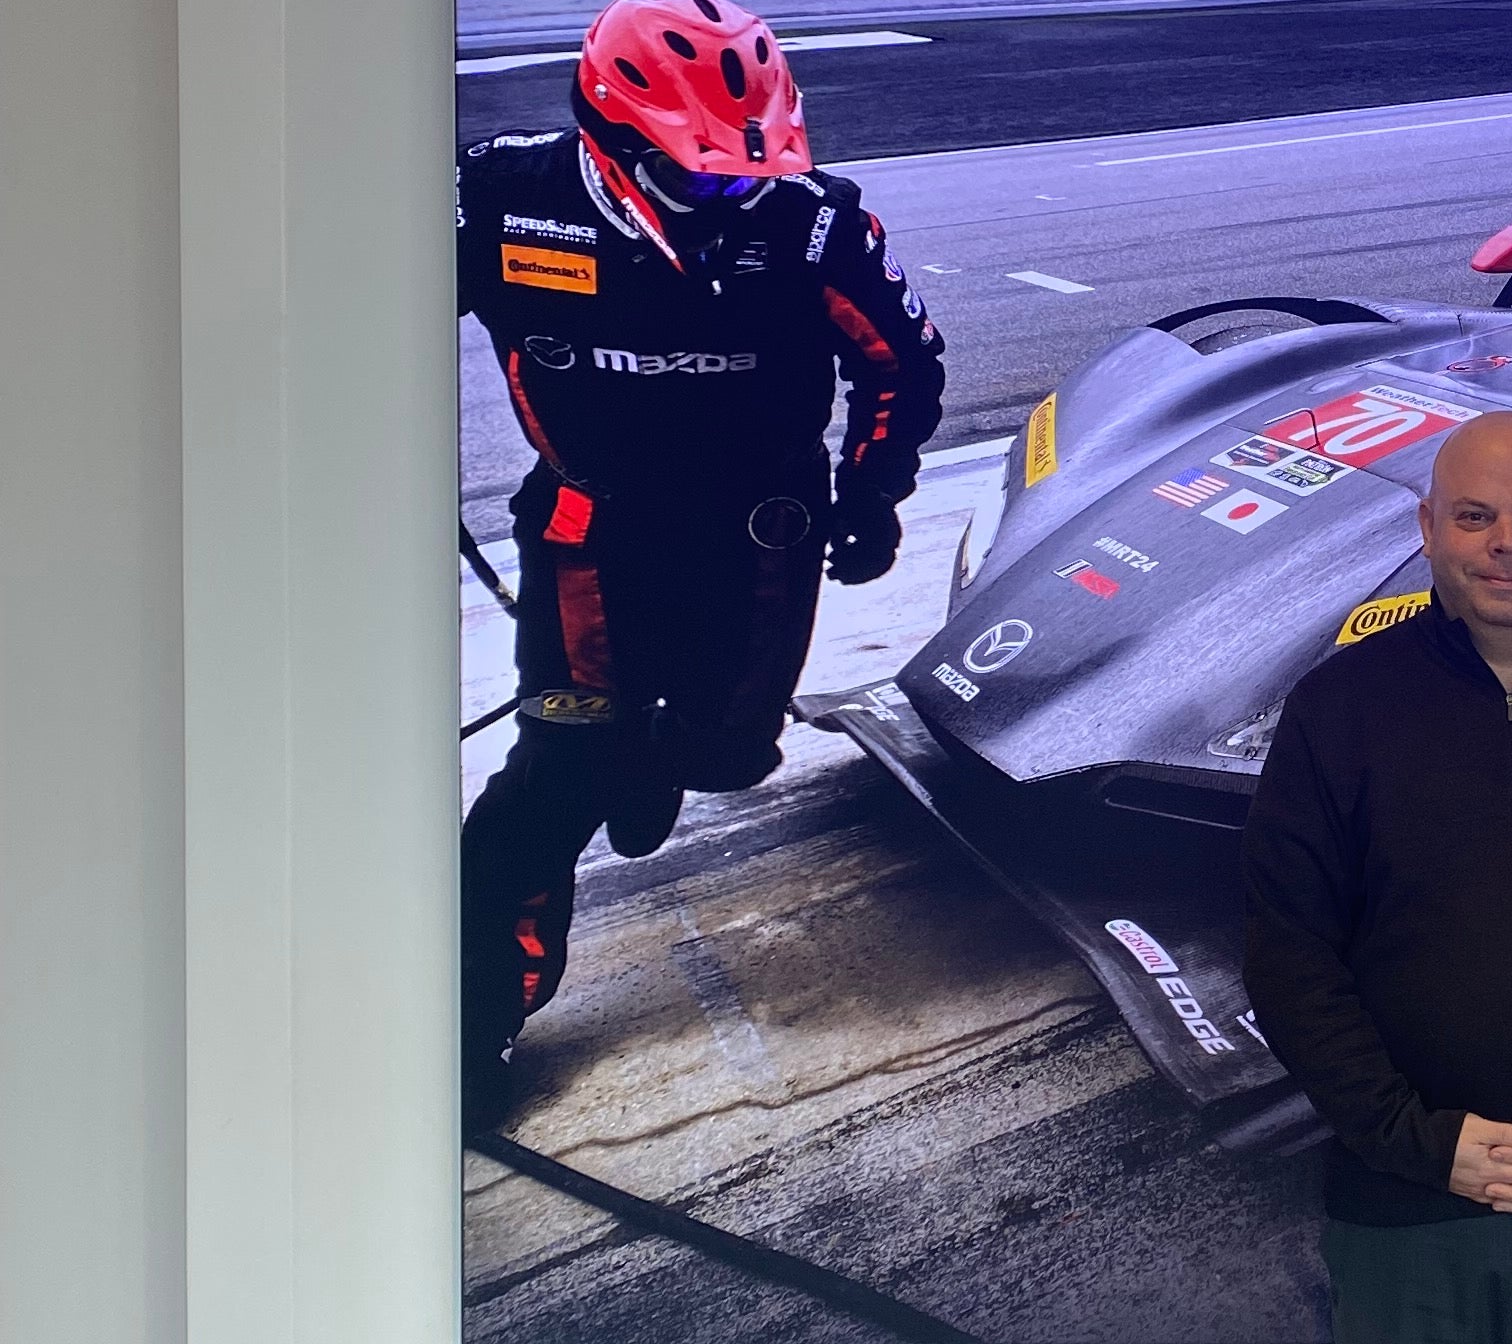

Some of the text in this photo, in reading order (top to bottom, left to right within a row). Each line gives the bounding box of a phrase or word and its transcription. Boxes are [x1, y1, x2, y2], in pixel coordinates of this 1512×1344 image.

[805, 206, 837, 263] sparco
[592, 347, 757, 375] mazda
[1370, 386, 1470, 424] WeatherTech
[1288, 398, 1427, 455] 70
[1092, 536, 1160, 573] #MRT24
[931, 662, 981, 702] mazda
[1116, 923, 1236, 1055] Castrol EDGE
